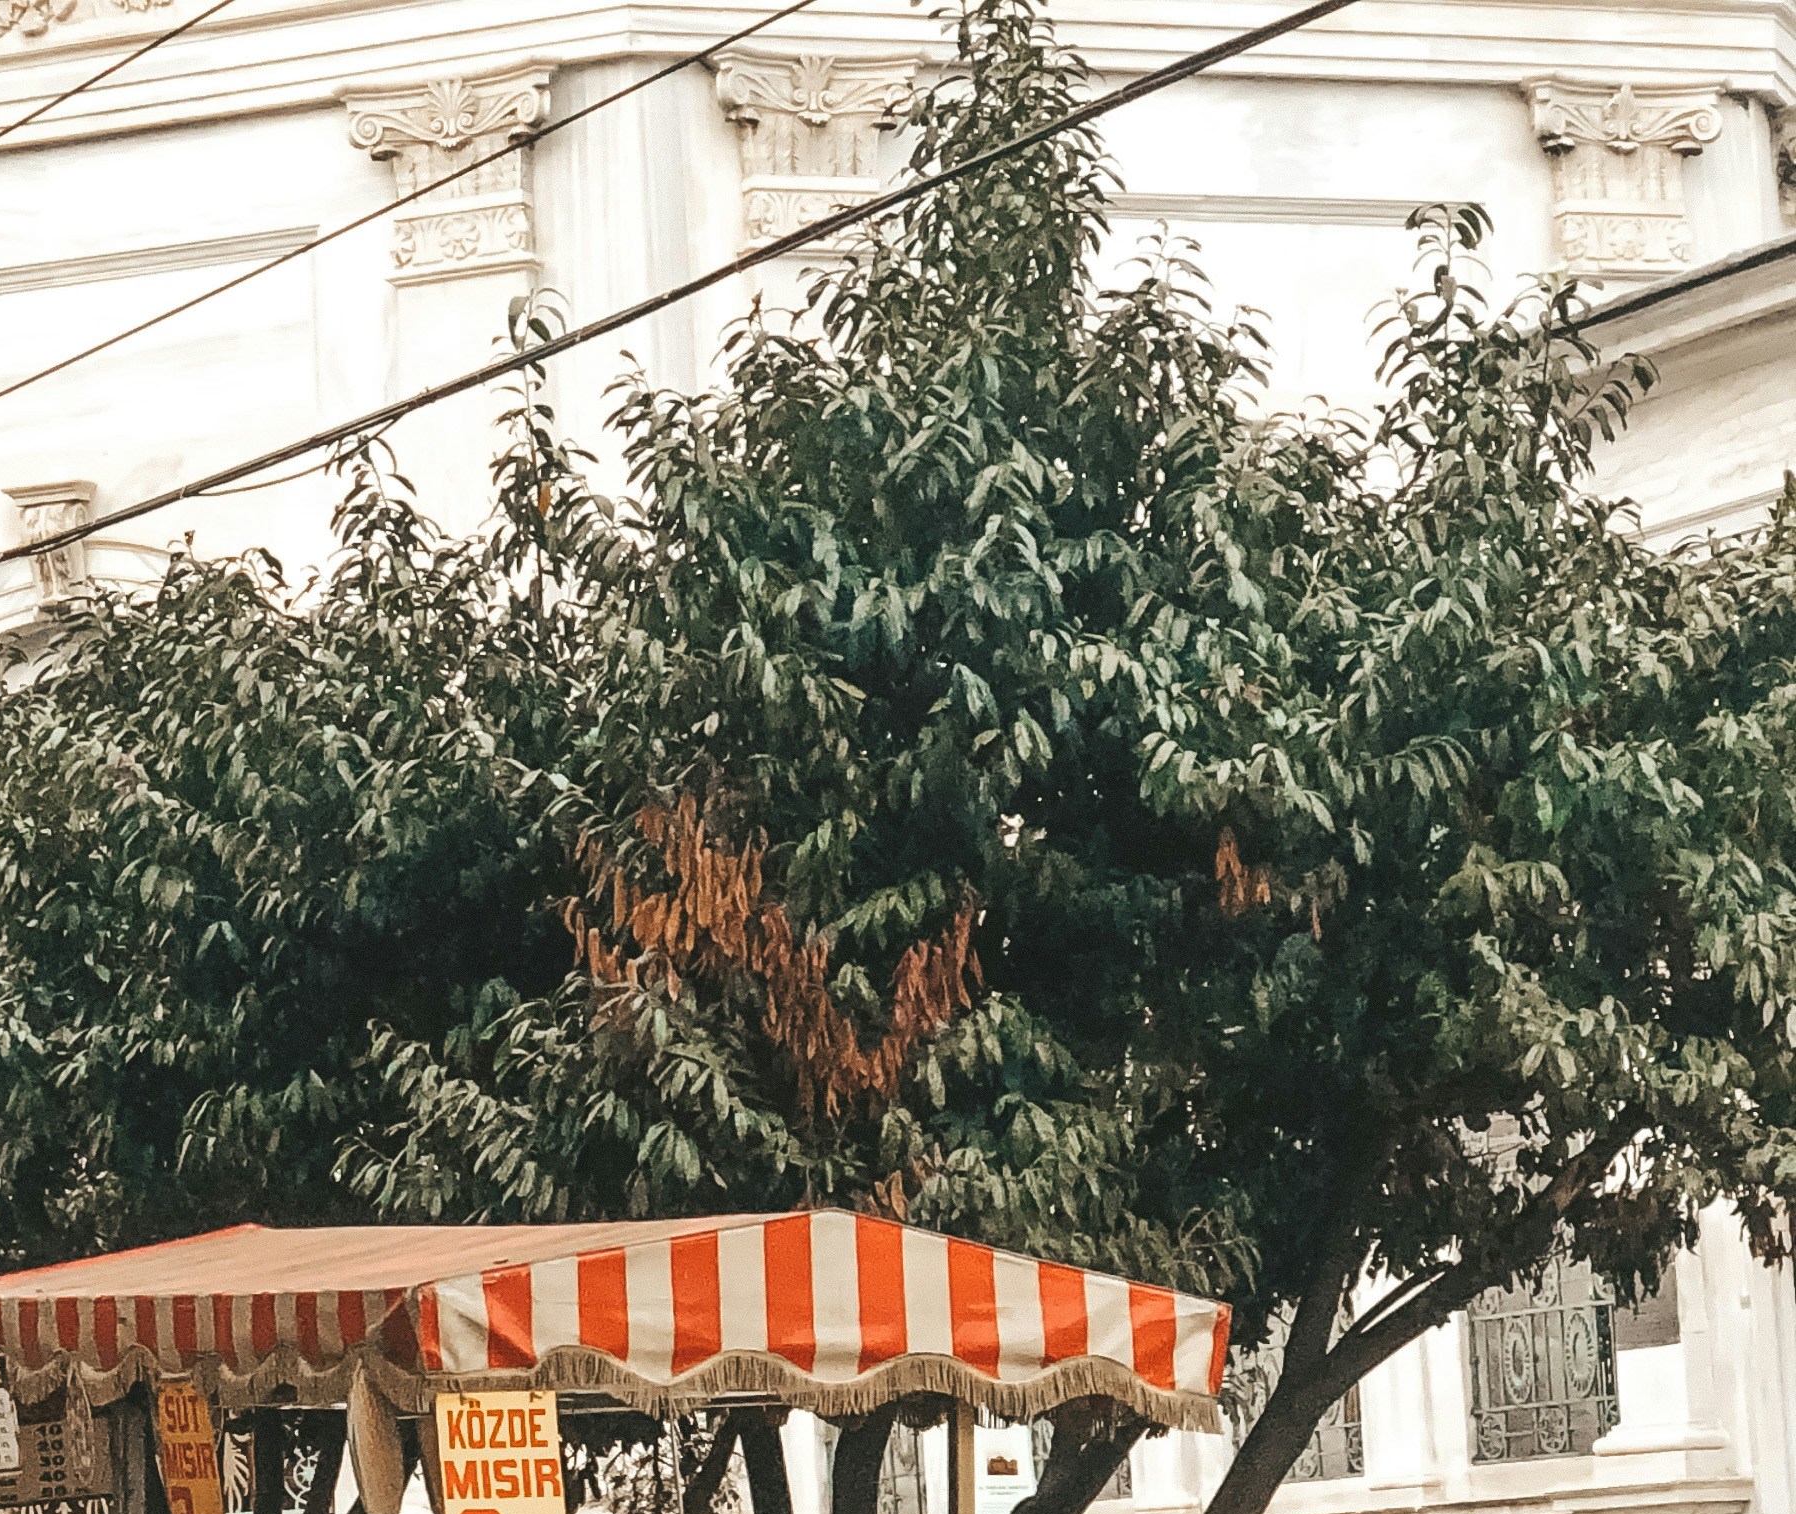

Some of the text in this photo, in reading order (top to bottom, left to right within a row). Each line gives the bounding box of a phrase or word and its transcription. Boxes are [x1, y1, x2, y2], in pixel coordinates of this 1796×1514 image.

[447, 1400, 549, 1449] KÖZDE
[164, 1442, 217, 1480] MISIR
[444, 1459, 562, 1500] MISIR
